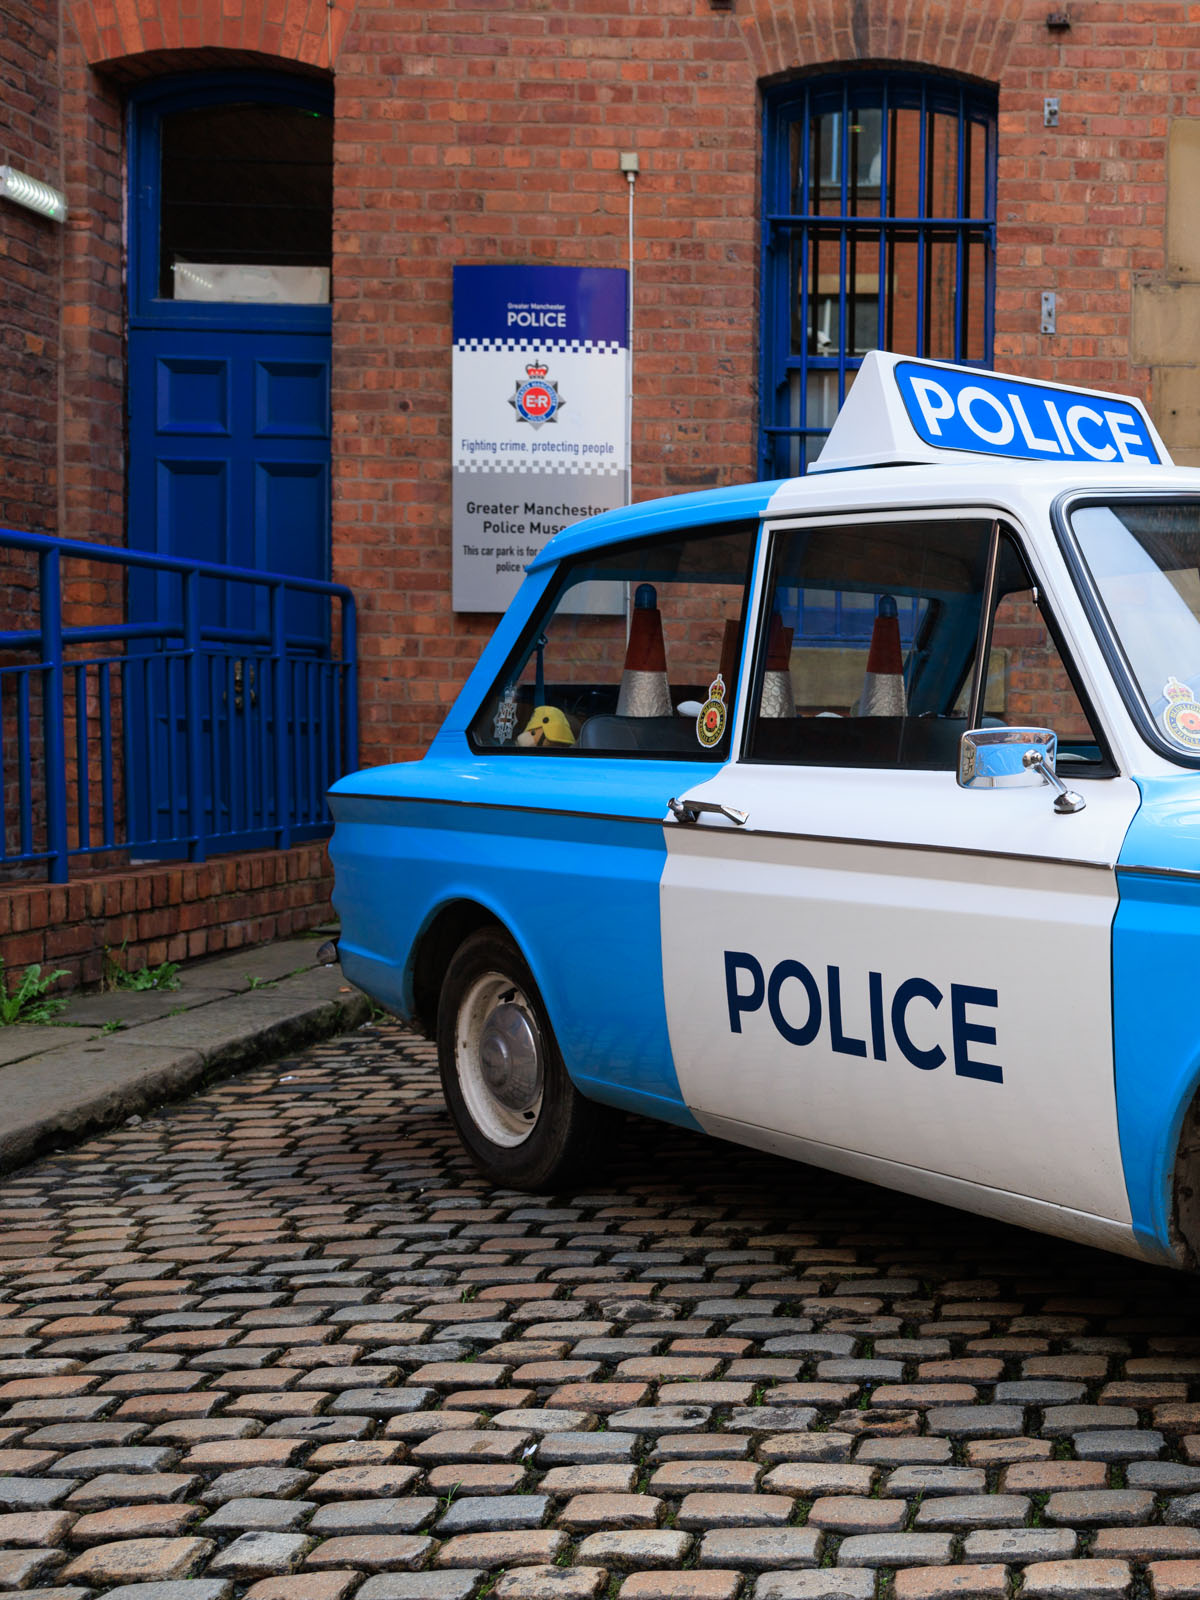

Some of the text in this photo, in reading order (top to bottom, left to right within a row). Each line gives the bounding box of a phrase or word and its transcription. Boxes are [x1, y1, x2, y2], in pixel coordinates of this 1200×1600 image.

[507, 312, 567, 328] POLICE
[909, 376, 1151, 464] POLICE
[461, 439, 497, 454] Fighting
[531, 442, 579, 455] protecting
[582, 443, 614, 455] people
[466, 501, 610, 516] Greater Manchester
[483, 520, 525, 534] Police
[463, 545, 479, 556] This
[481, 547, 494, 556] car
[496, 545, 514, 559] park
[517, 546, 524, 556] is
[526, 546, 537, 557] for
[496, 561, 520, 573] police
[724, 950, 1004, 1084] POLICE
